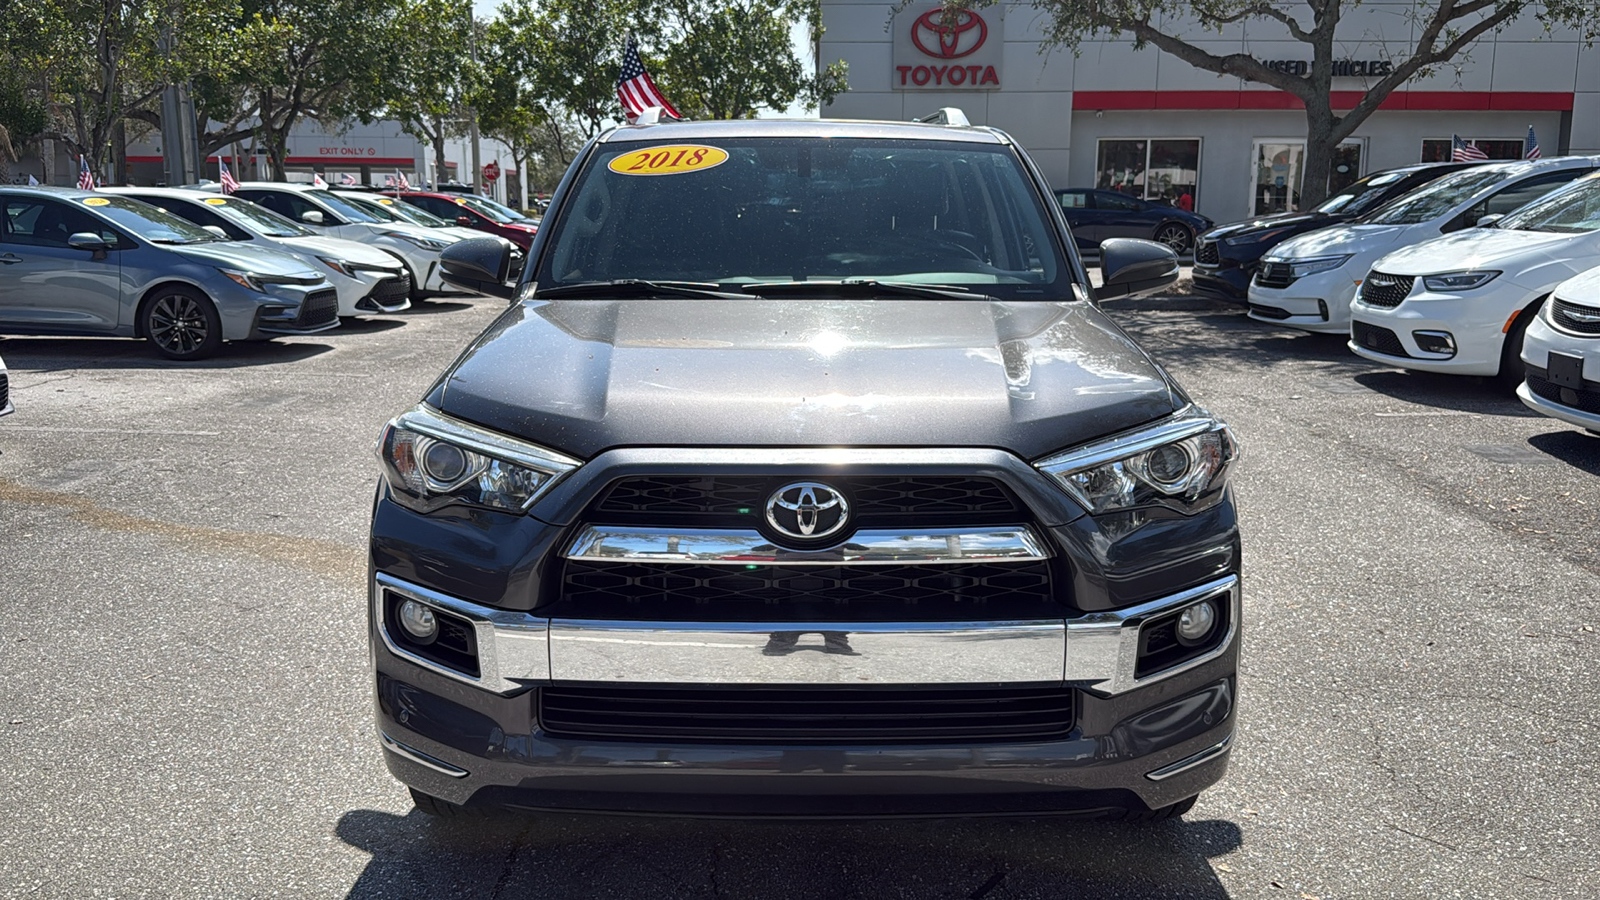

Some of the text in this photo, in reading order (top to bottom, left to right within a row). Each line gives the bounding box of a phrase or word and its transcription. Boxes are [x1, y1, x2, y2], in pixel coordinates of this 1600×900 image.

[896, 65, 1000, 86] TOYOTA
[1311, 60, 1392, 76] HICLES
[319, 147, 364, 155] EXIT ONLY
[627, 148, 709, 171] 2018
